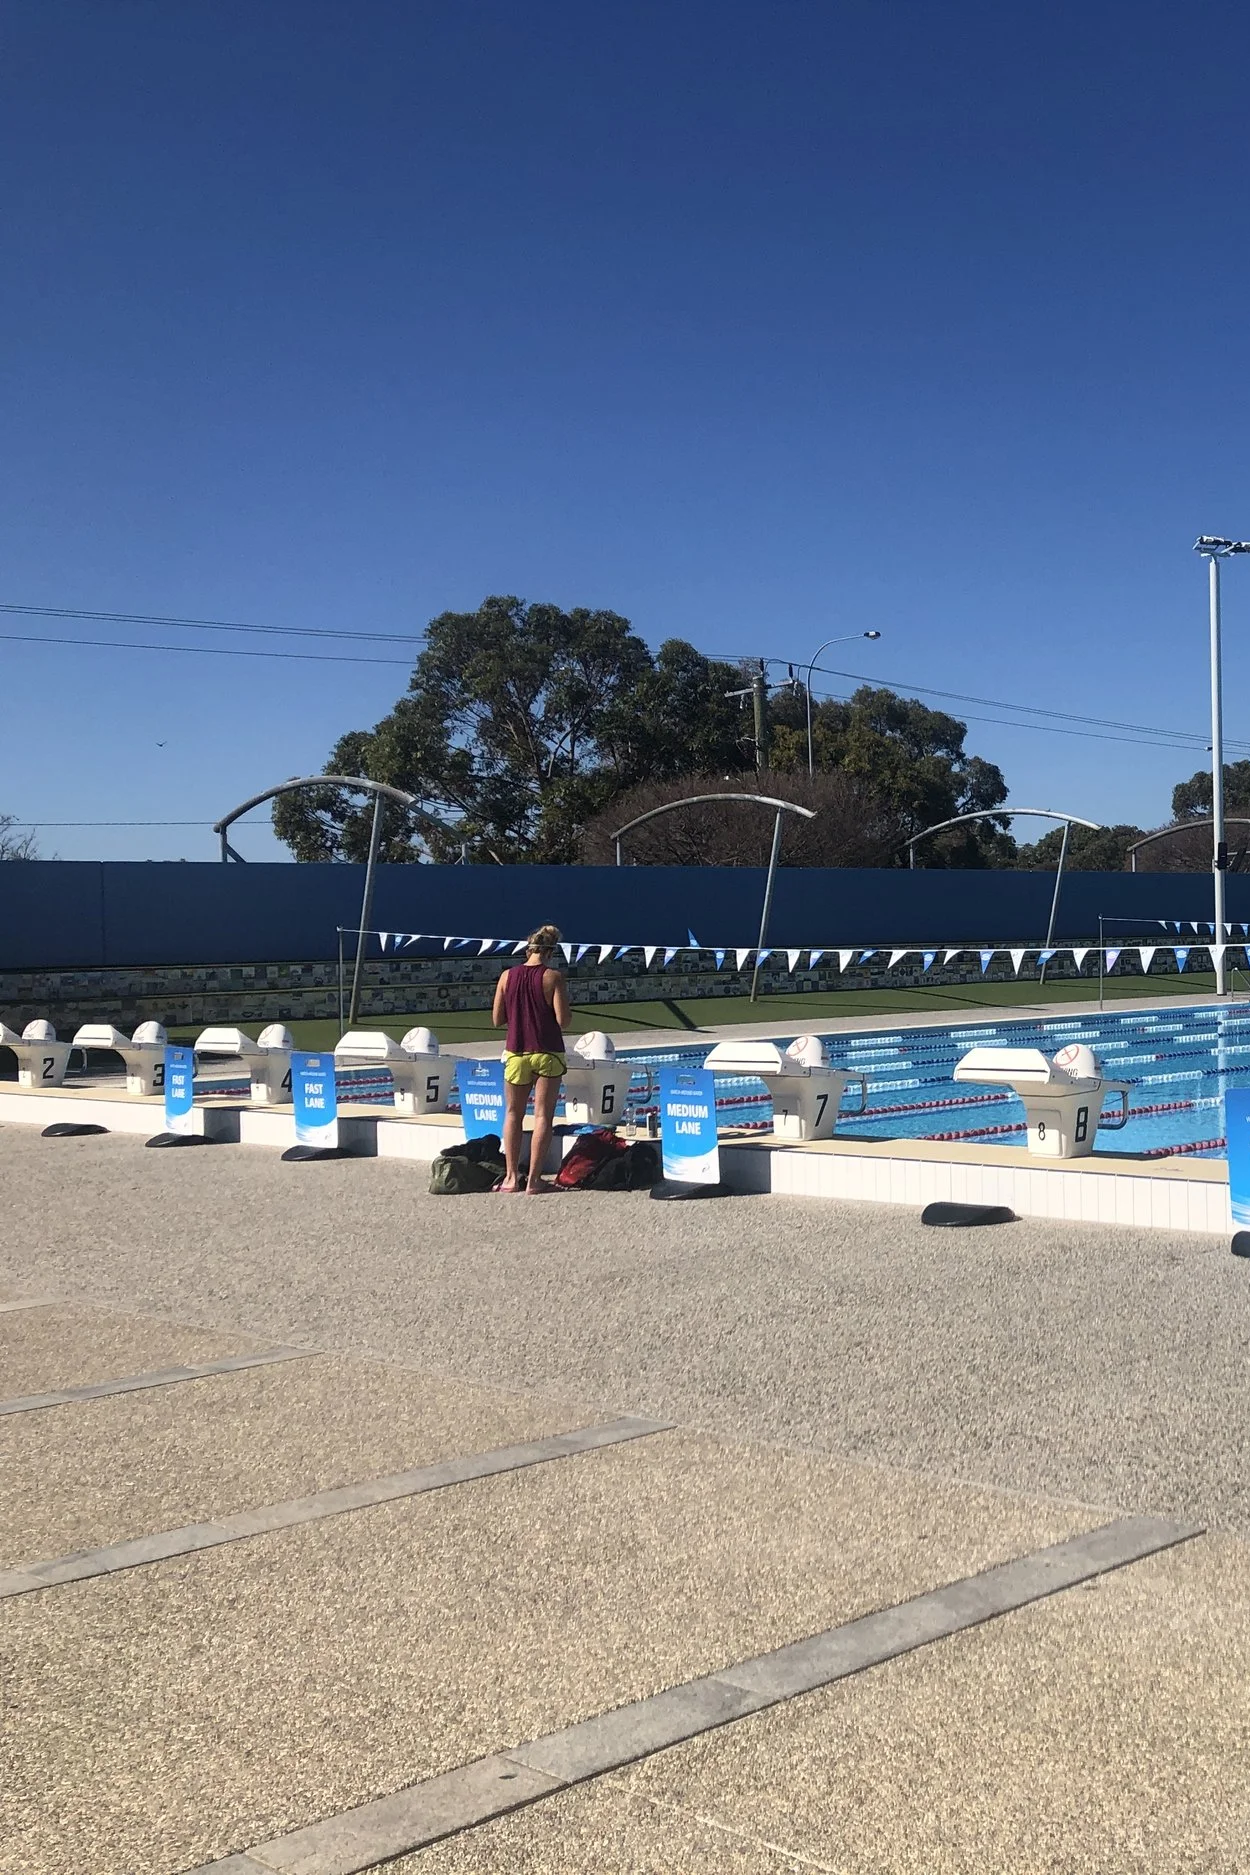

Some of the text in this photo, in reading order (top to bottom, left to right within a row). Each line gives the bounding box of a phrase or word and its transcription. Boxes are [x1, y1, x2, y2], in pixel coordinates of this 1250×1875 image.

[43, 1057, 54, 1079] 2
[153, 1063, 165, 1087] 3
[172, 1075, 185, 1085] FAST
[281, 1068, 292, 1092] 4
[172, 1088, 185, 1098] LANE
[304, 1083, 323, 1095] FAST
[426, 1076, 440, 1103] 5
[304, 1097, 325, 1108] LANE
[465, 1093, 503, 1107] MEDIUM
[601, 1085, 615, 1114] 6
[474, 1108, 497, 1121] LANE
[667, 1103, 708, 1118] MEDIUM
[782, 1109, 788, 1126] 7
[815, 1094, 829, 1127] 7
[675, 1120, 702, 1135] LANE
[1038, 1121, 1045, 1141] 8
[1075, 1106, 1089, 1142] 8
